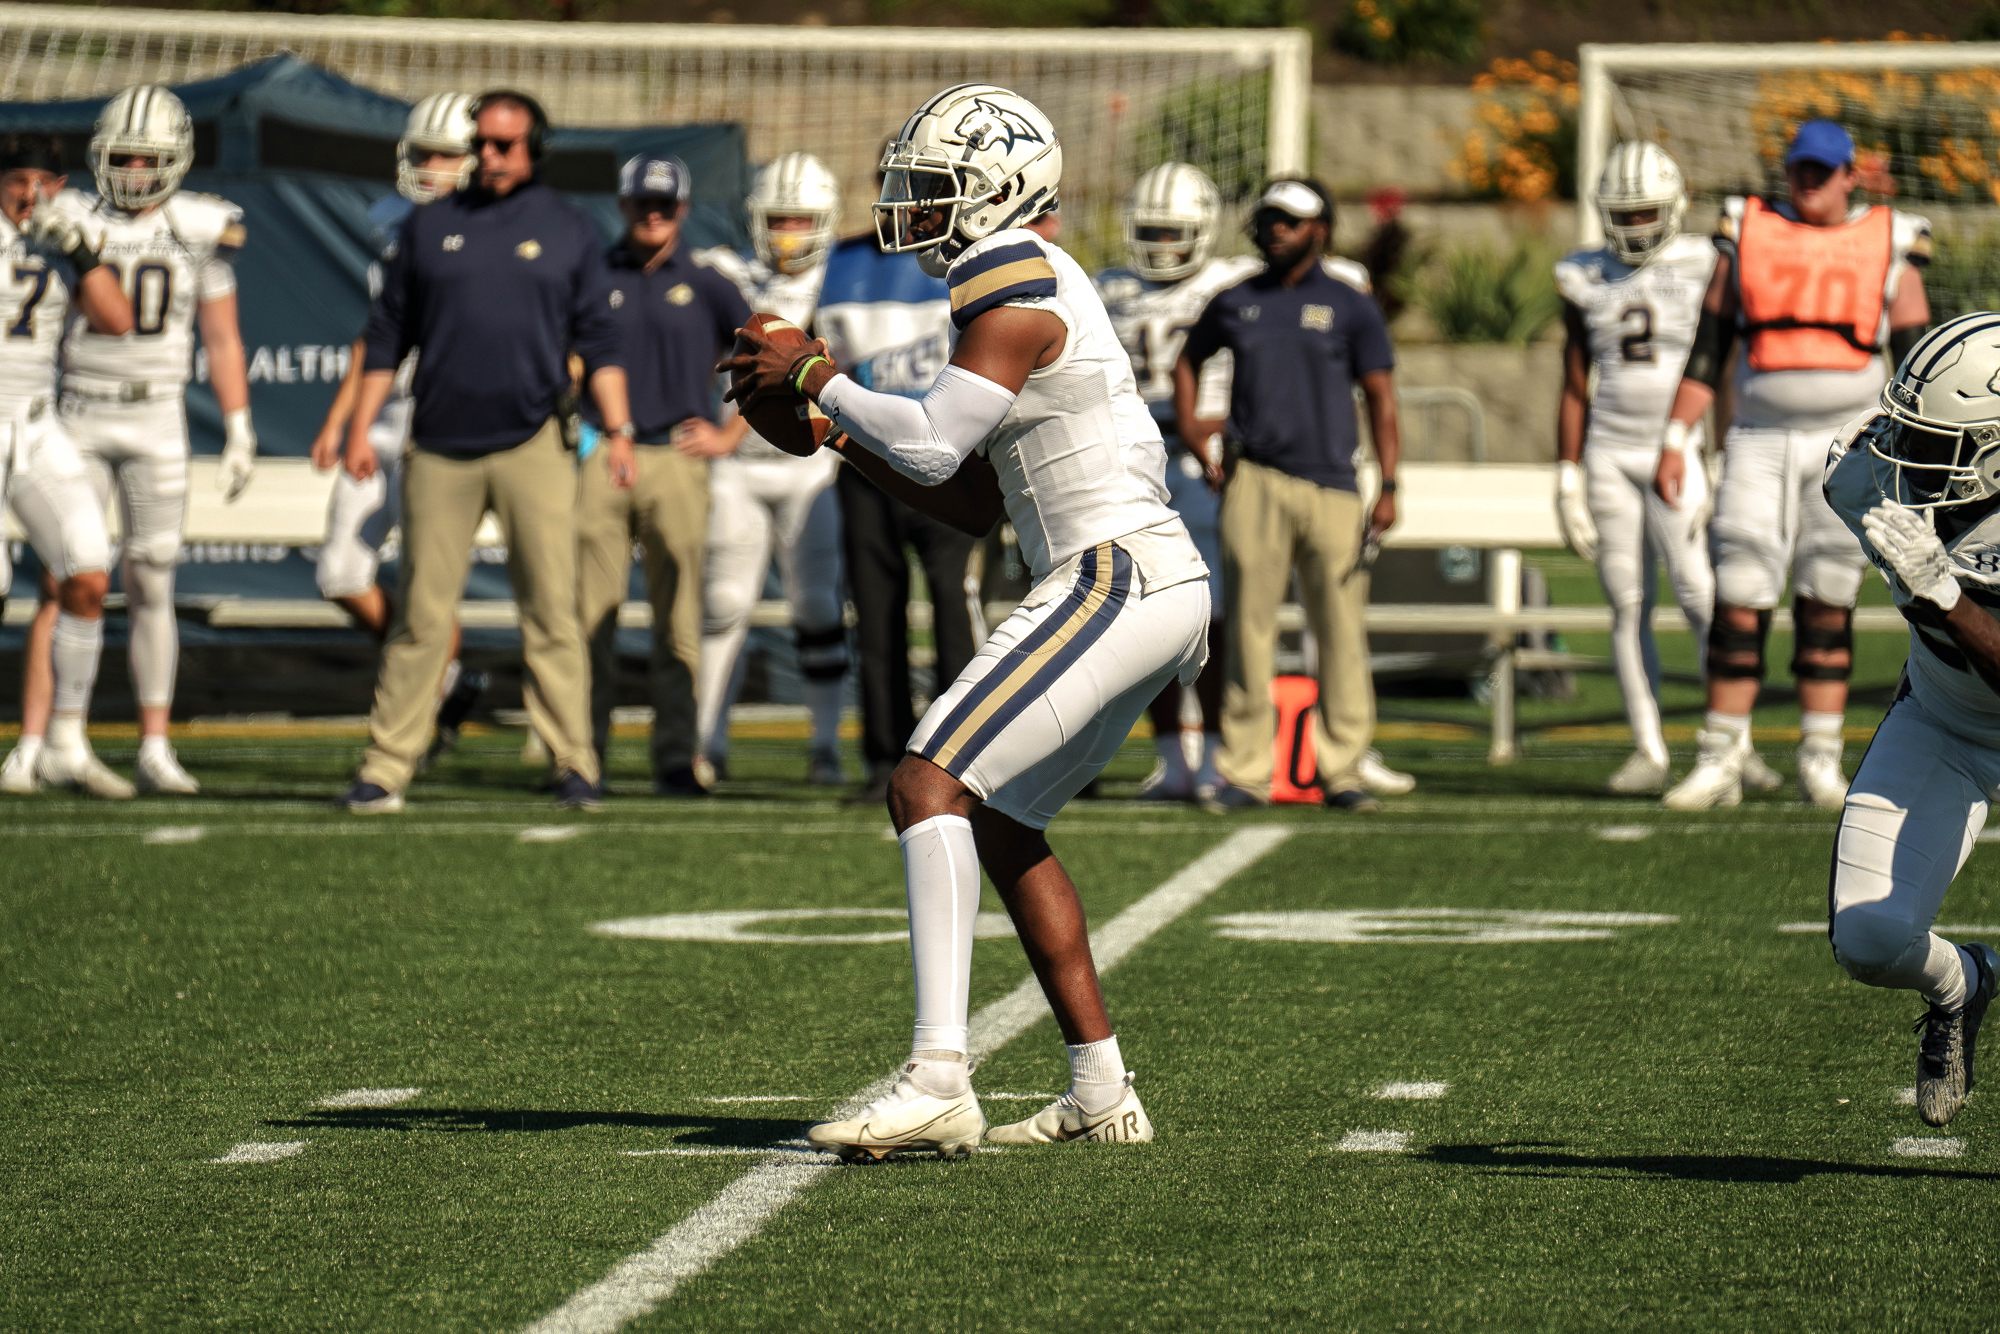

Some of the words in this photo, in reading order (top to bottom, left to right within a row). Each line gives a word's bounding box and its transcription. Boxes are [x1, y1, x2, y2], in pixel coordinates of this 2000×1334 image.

[9, 264, 51, 337] 7
[88, 262, 170, 336] 0
[1771, 263, 1858, 324] 70
[195, 344, 351, 384] ALTH
[1619, 303, 1657, 365] 2
[1896, 387, 1913, 404] 406
